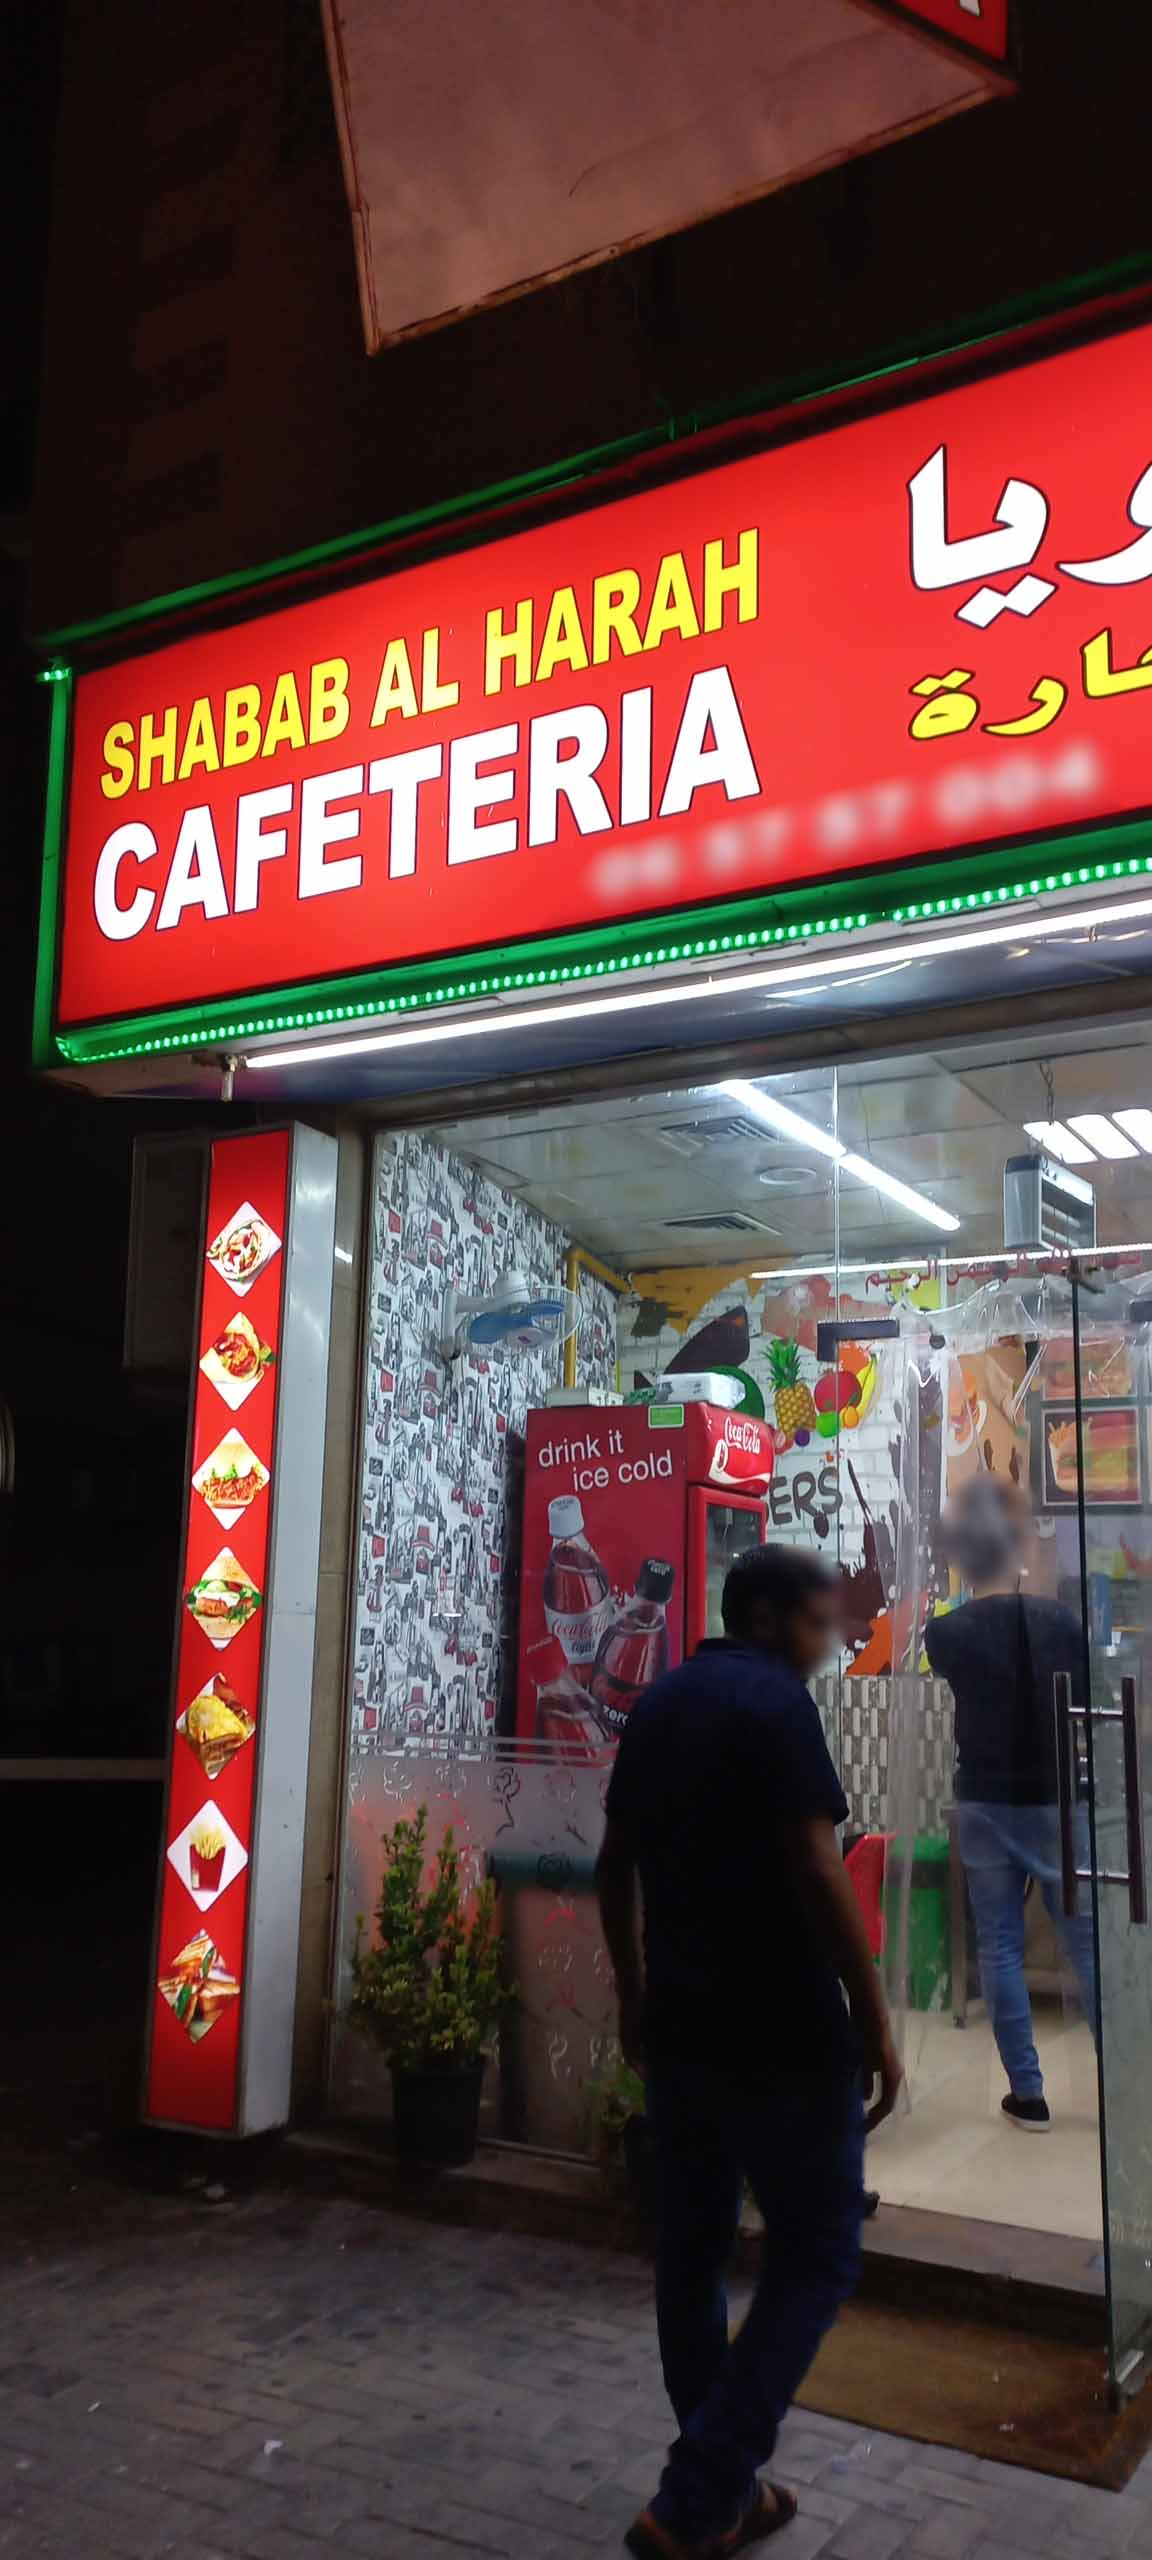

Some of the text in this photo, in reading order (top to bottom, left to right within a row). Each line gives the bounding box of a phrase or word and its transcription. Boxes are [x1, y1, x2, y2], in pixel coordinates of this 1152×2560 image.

[101, 527, 759, 799] SHABAB AL HARAH
[93, 664, 762, 941] CAFETERIA
[538, 1429, 624, 1467] drink it
[573, 1450, 672, 1491] ice cold
[766, 1467, 842, 1525] ERS
